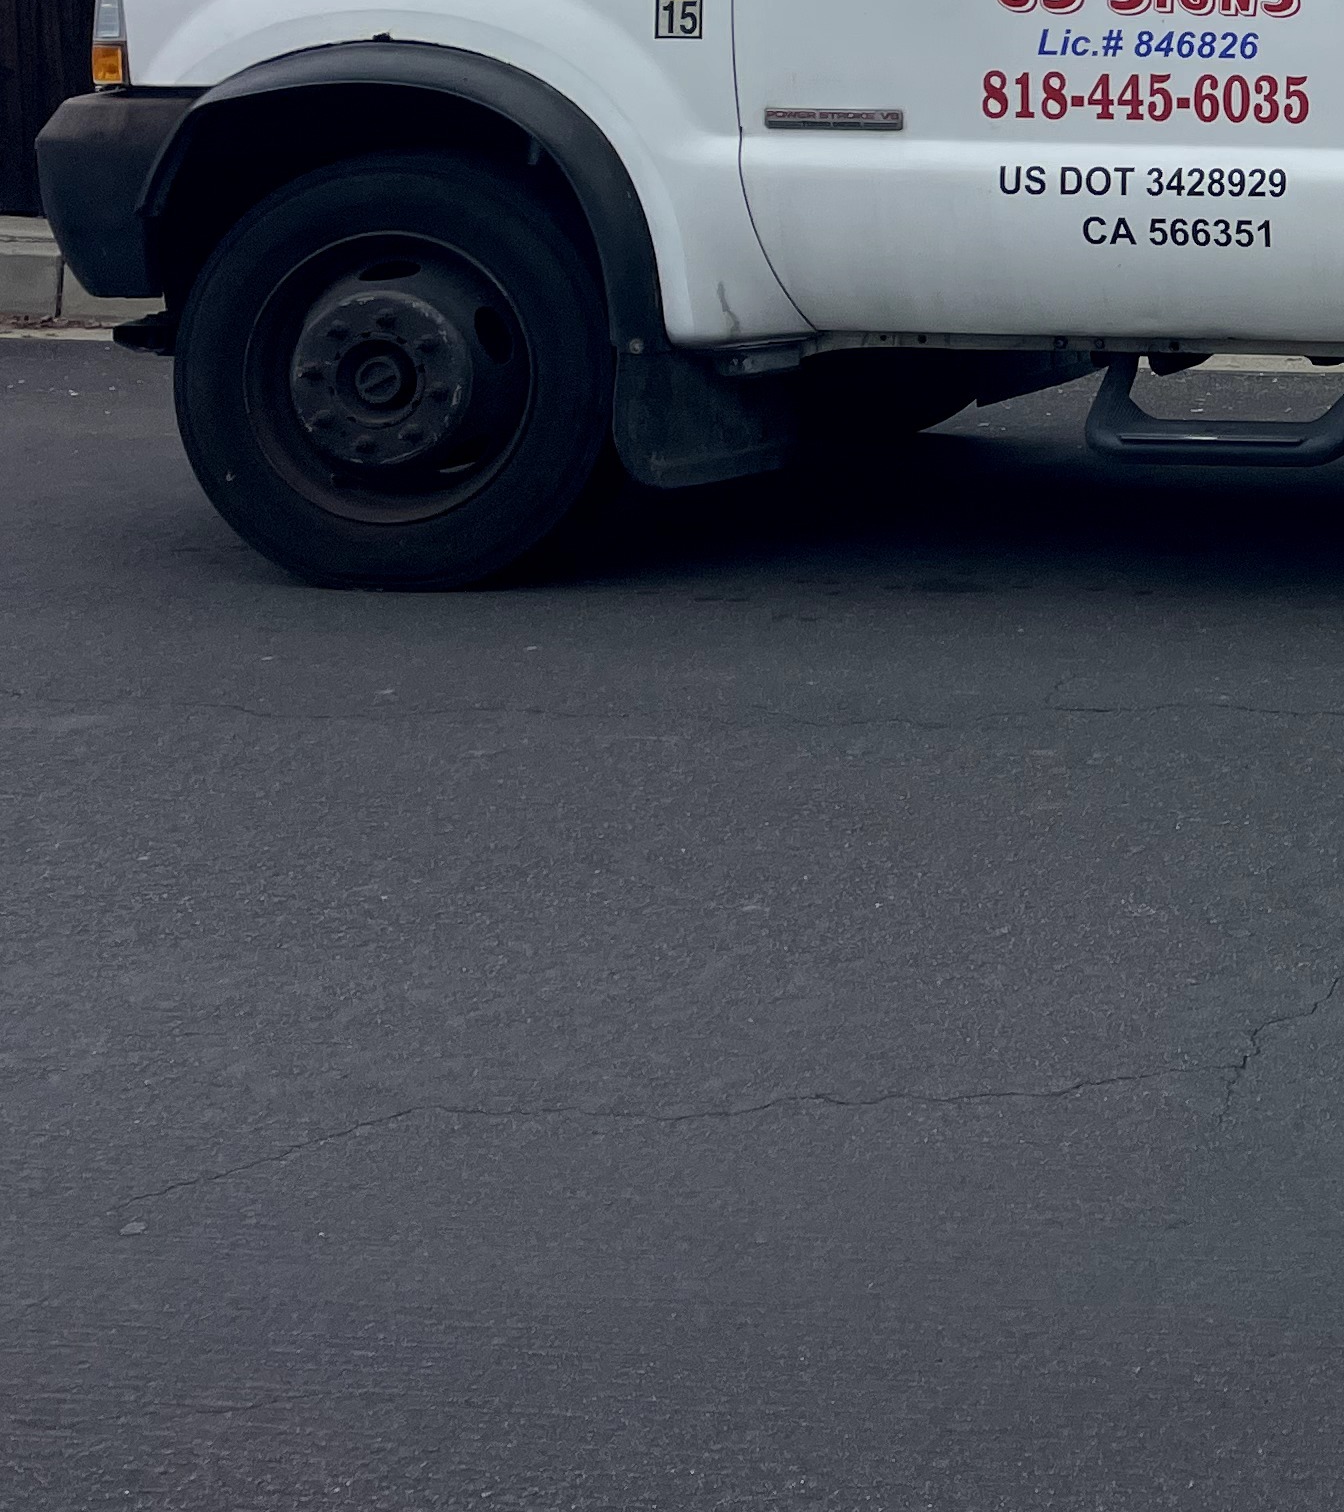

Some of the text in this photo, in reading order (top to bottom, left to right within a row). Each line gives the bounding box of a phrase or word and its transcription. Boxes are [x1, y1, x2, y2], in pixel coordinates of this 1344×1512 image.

[662, 0, 698, 35] 15
[1037, 28, 1260, 59] Lic.# 846826
[982, 70, 1310, 124] 818-445-6035
[766, 110, 817, 119] POWER
[819, 111, 875, 120] STROKE
[1000, 166, 1288, 197] US DOT 3428929
[1082, 217, 1272, 248] CA 566351
